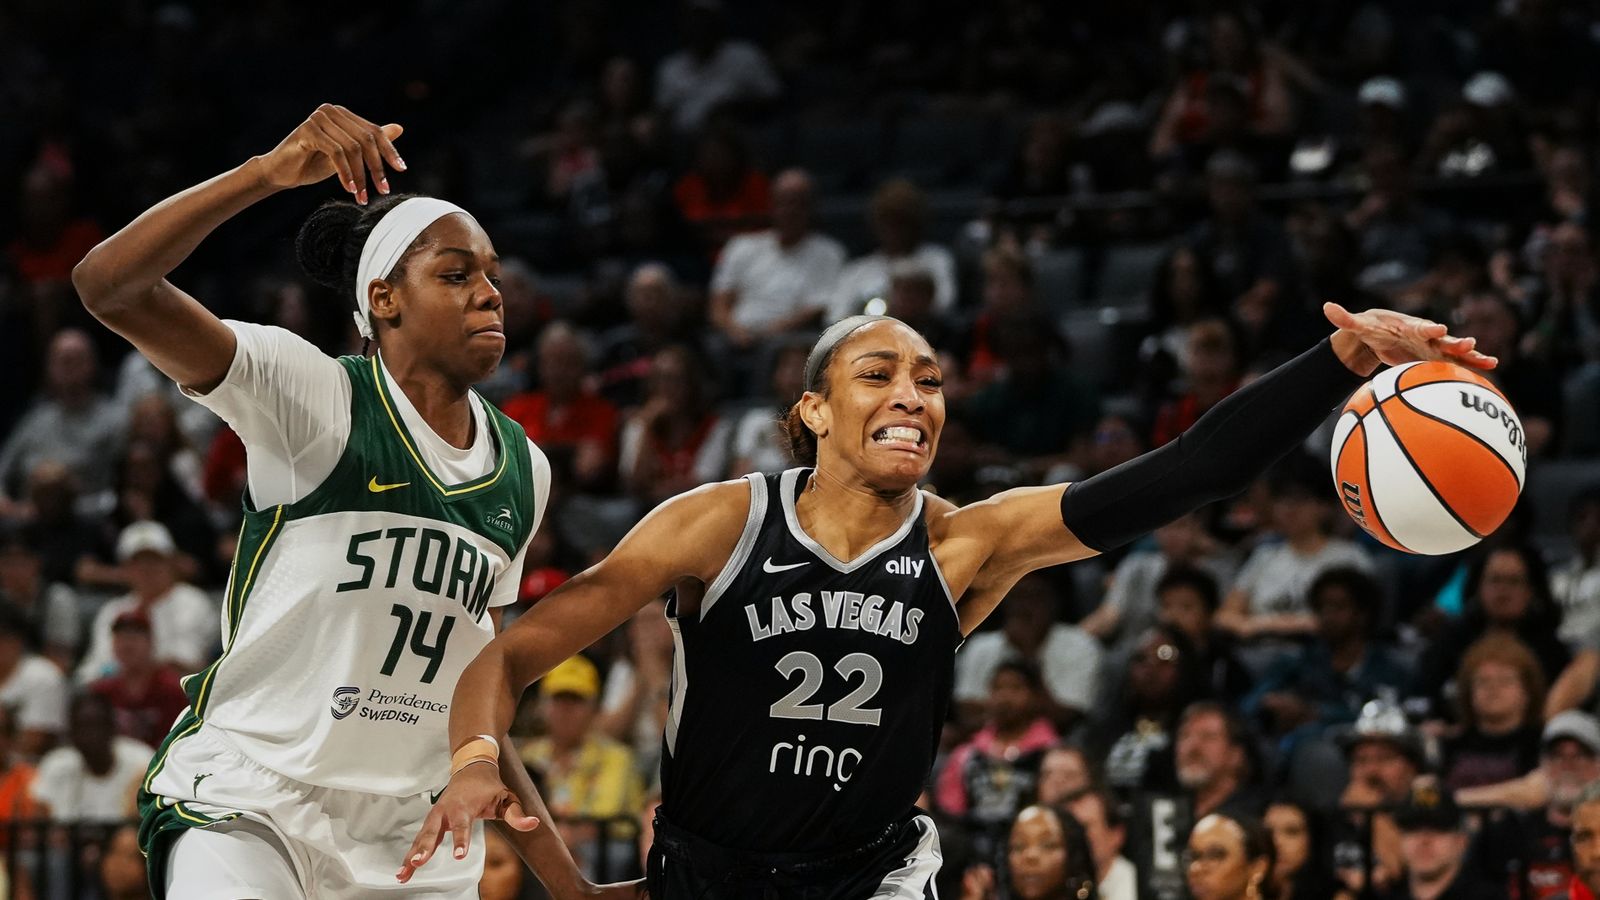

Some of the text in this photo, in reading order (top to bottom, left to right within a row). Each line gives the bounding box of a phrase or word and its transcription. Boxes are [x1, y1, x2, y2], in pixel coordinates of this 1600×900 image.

[336, 527, 495, 624] STORM
[885, 556, 925, 578] ally
[380, 603, 456, 684] 14
[744, 590, 925, 645] LAS VEGAS
[359, 706, 420, 725] SWEDISH
[367, 688, 448, 714] Providence
[769, 650, 883, 726] 22
[769, 734, 863, 792] ring
